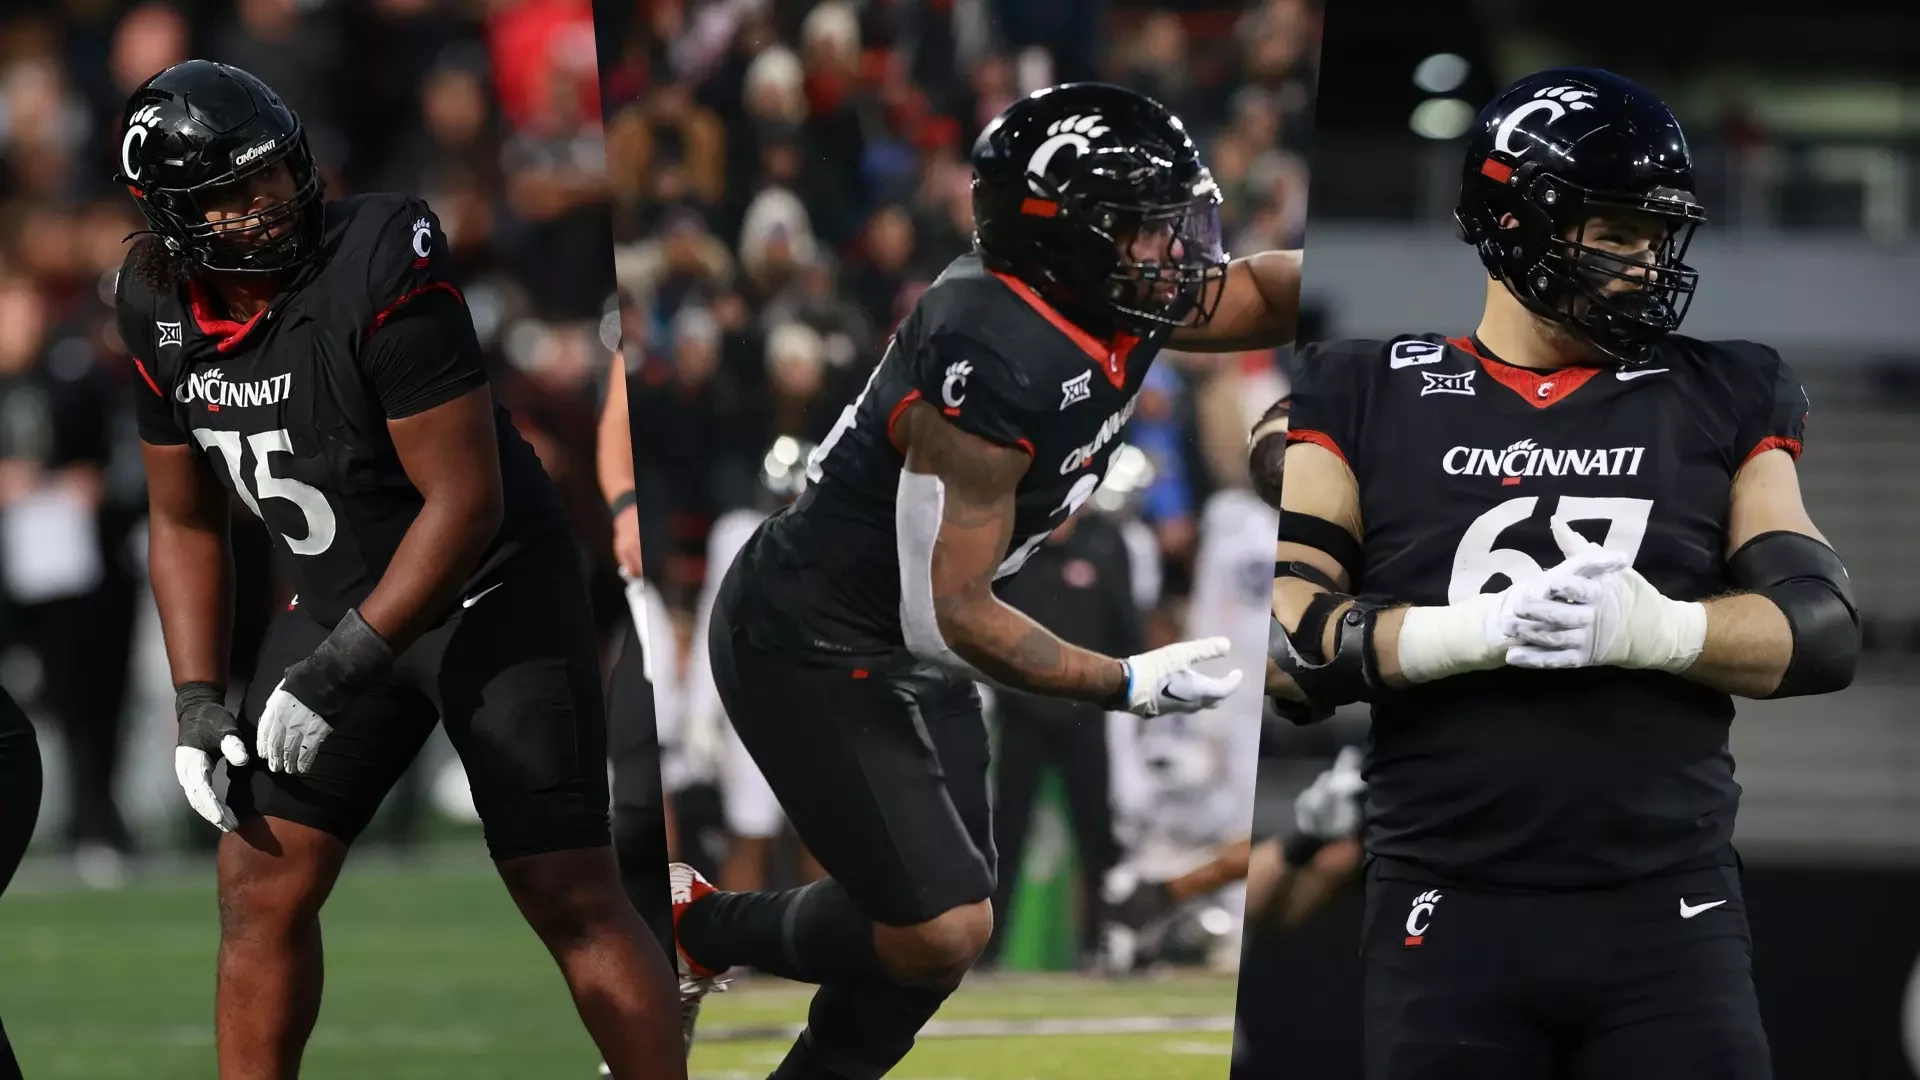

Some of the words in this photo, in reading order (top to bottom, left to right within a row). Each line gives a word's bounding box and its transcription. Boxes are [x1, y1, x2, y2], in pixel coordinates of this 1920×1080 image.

[175, 370, 291, 408] CNCINNATI
[192, 427, 336, 556] 75
[1442, 441, 1646, 477] CINCINNATI
[1447, 495, 1654, 607] 67
